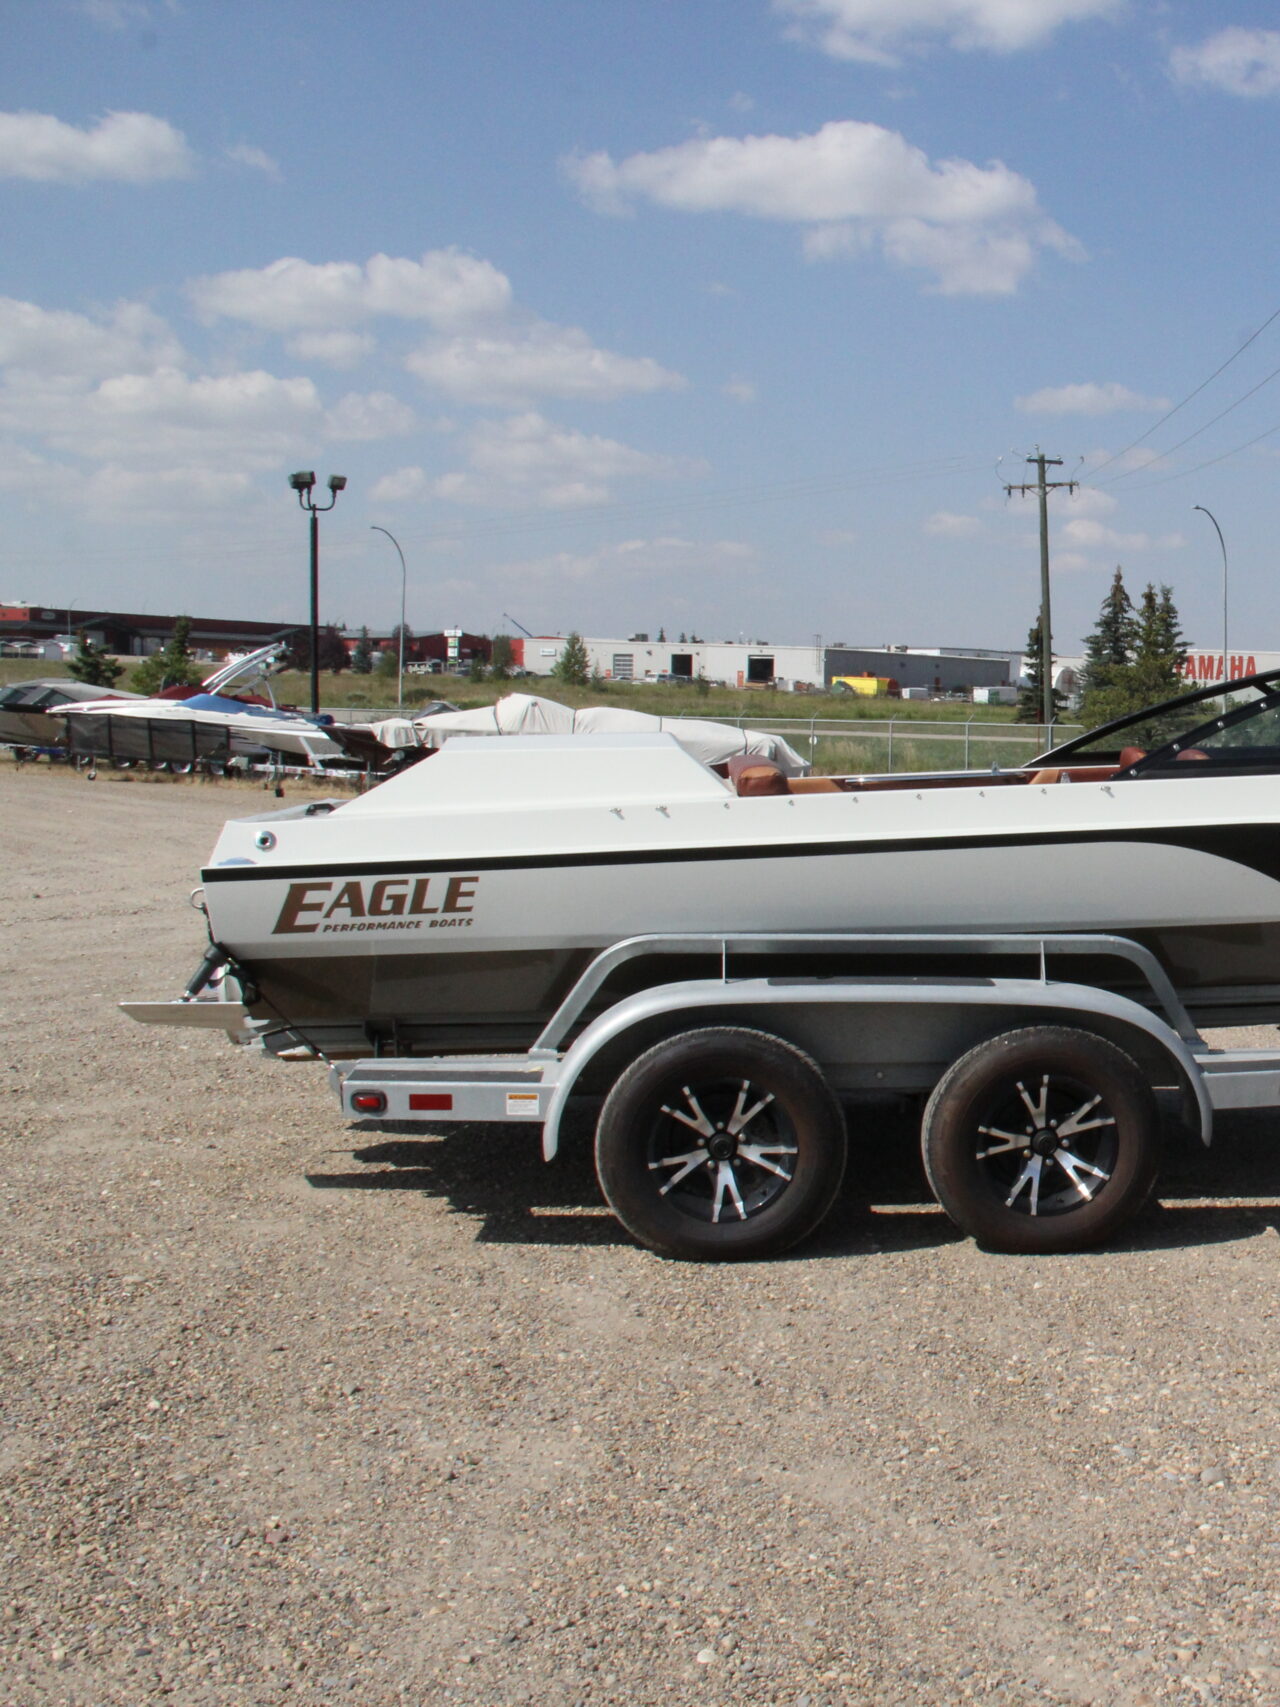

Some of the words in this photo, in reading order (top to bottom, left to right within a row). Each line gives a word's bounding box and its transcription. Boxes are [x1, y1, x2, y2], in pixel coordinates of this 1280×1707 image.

[1174, 655, 1257, 681] AMAHA
[271, 876, 480, 934] EAGLE
[322, 920, 423, 933] PERFORMANCE
[429, 918, 474, 928] BOATS
